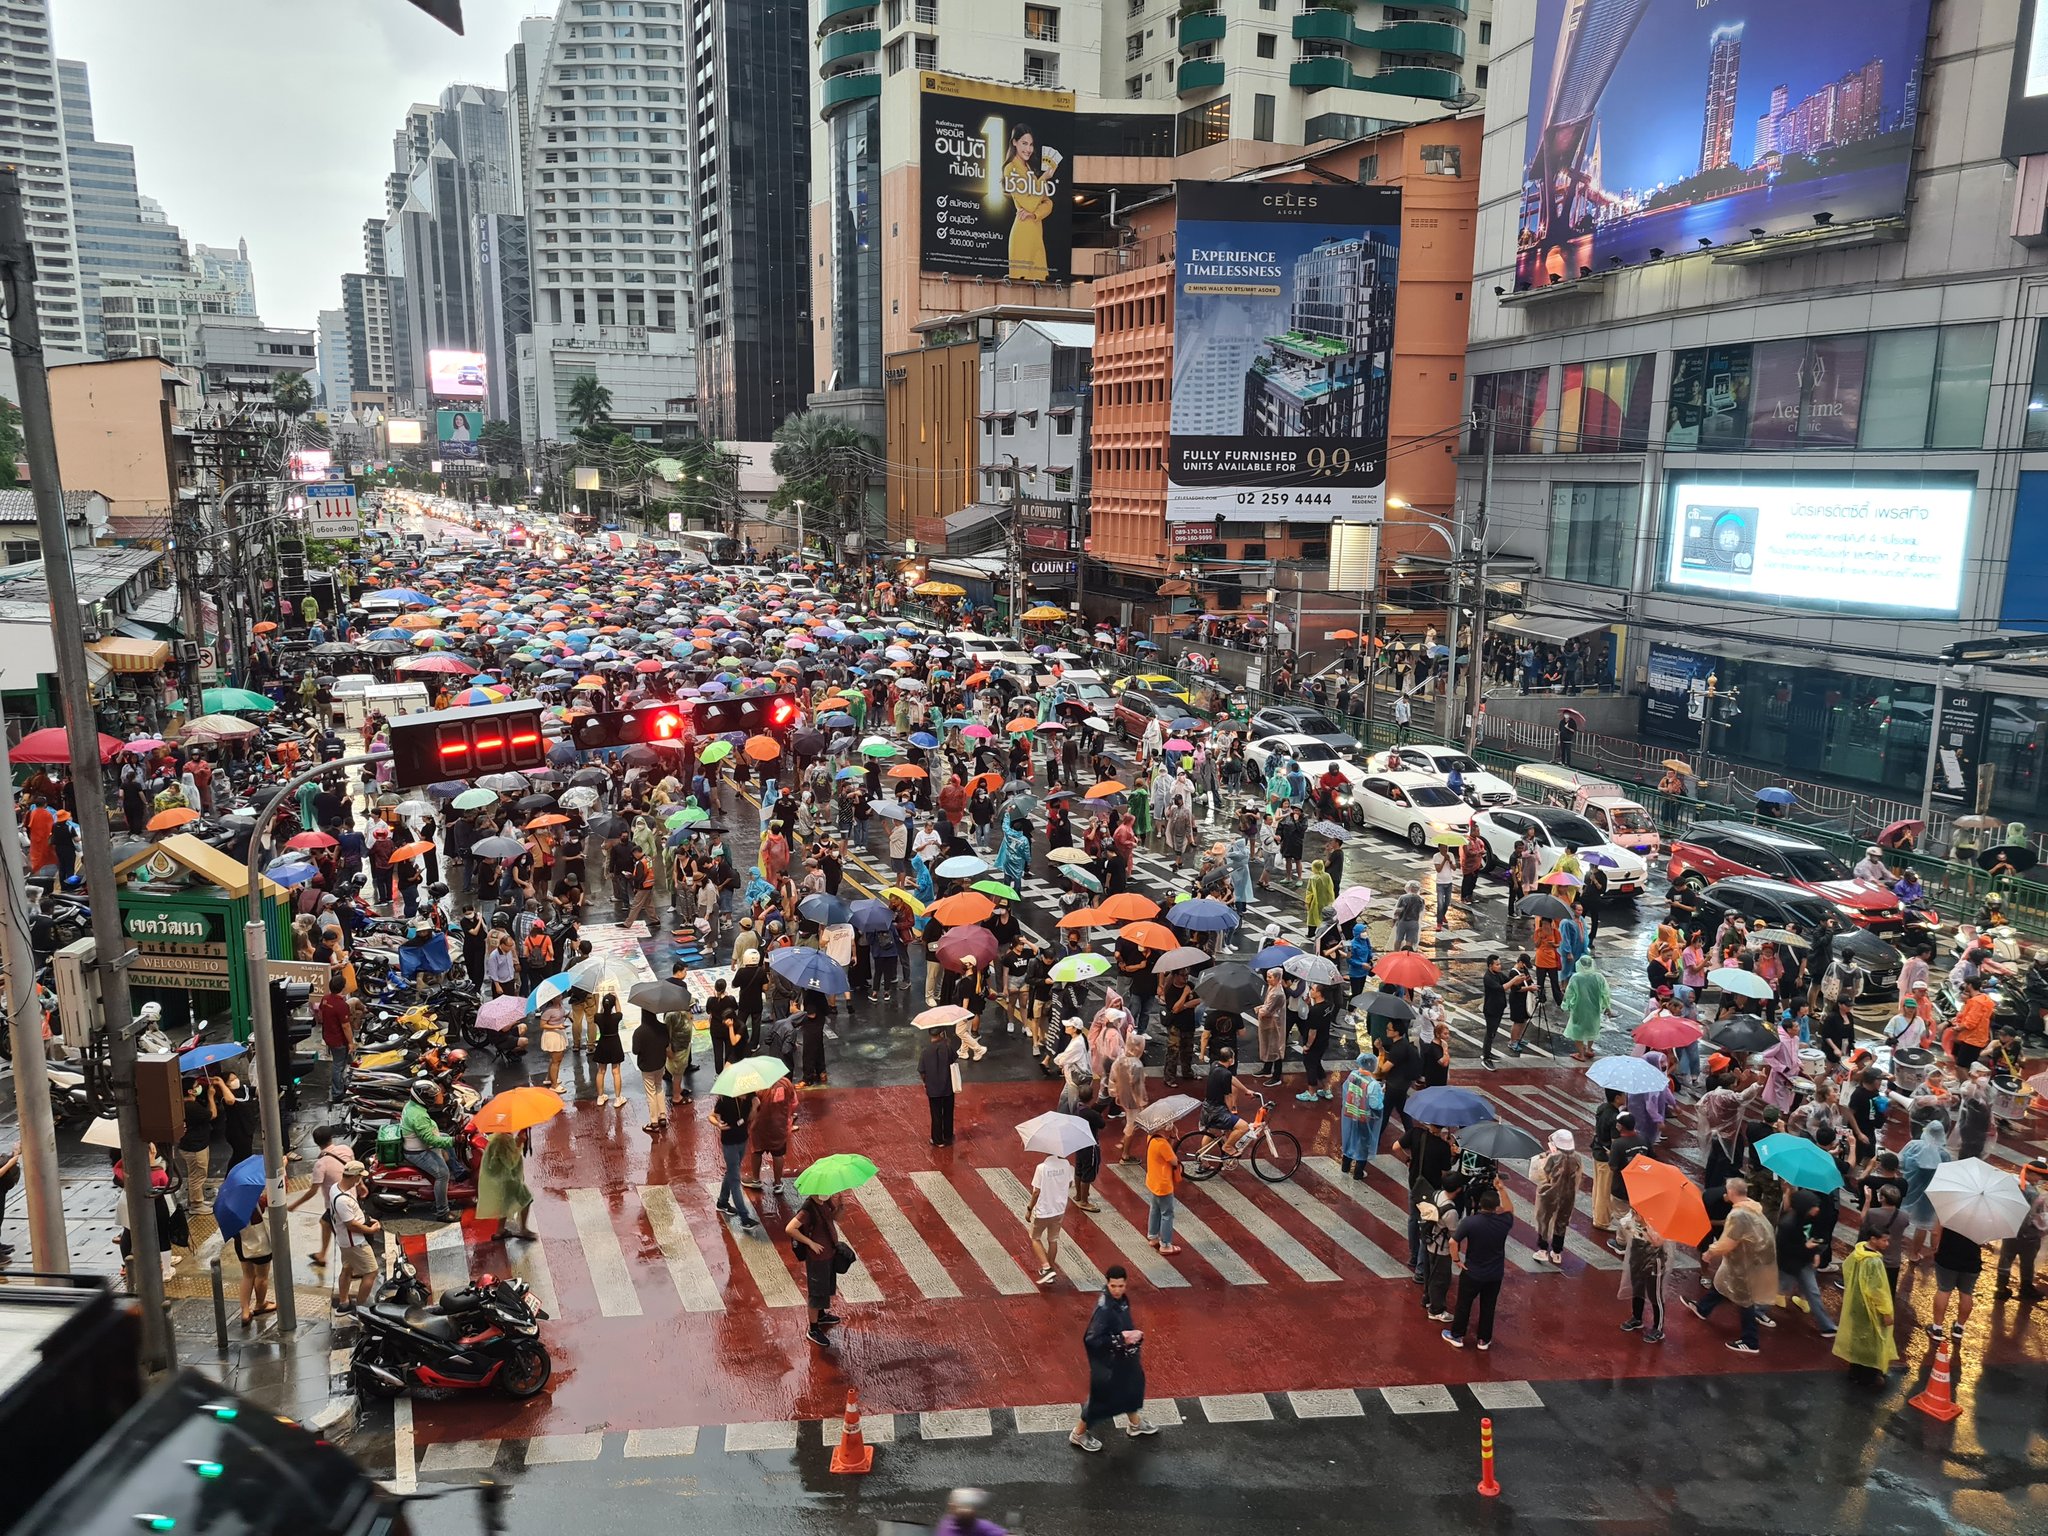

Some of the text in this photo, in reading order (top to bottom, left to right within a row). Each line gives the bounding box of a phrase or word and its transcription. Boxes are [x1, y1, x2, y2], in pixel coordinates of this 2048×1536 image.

[936, 128, 964, 138] พรอมิส
[935, 136, 986, 162] อนุมัติ
[980, 116, 1004, 200] 1
[950, 162, 986, 178] ทันใจใน
[950, 198, 980, 210] สมัครง่าย
[1263, 194, 1318, 208] CELES
[480, 219, 489, 264] FICO
[1324, 242, 1358, 257] CELES
[1183, 450, 1297, 461] FULLY FURNISHED
[1306, 447, 1351, 478] 9.9
[1183, 462, 1296, 471] UNITS AVAILABLE FOR
[1237, 493, 1332, 505] 02 259 4444
[1030, 505, 1062, 519] COWBOY
[1790, 501, 1869, 518] บัตรเครดิตซิตี้
[1952, 698, 1968, 707] citi
[129, 914, 203, 936] เขตวัฒนา
[143, 958, 219, 971] WELCOME TO
[128, 974, 181, 986] VADHANA
[310, 974, 324, 985] 21
